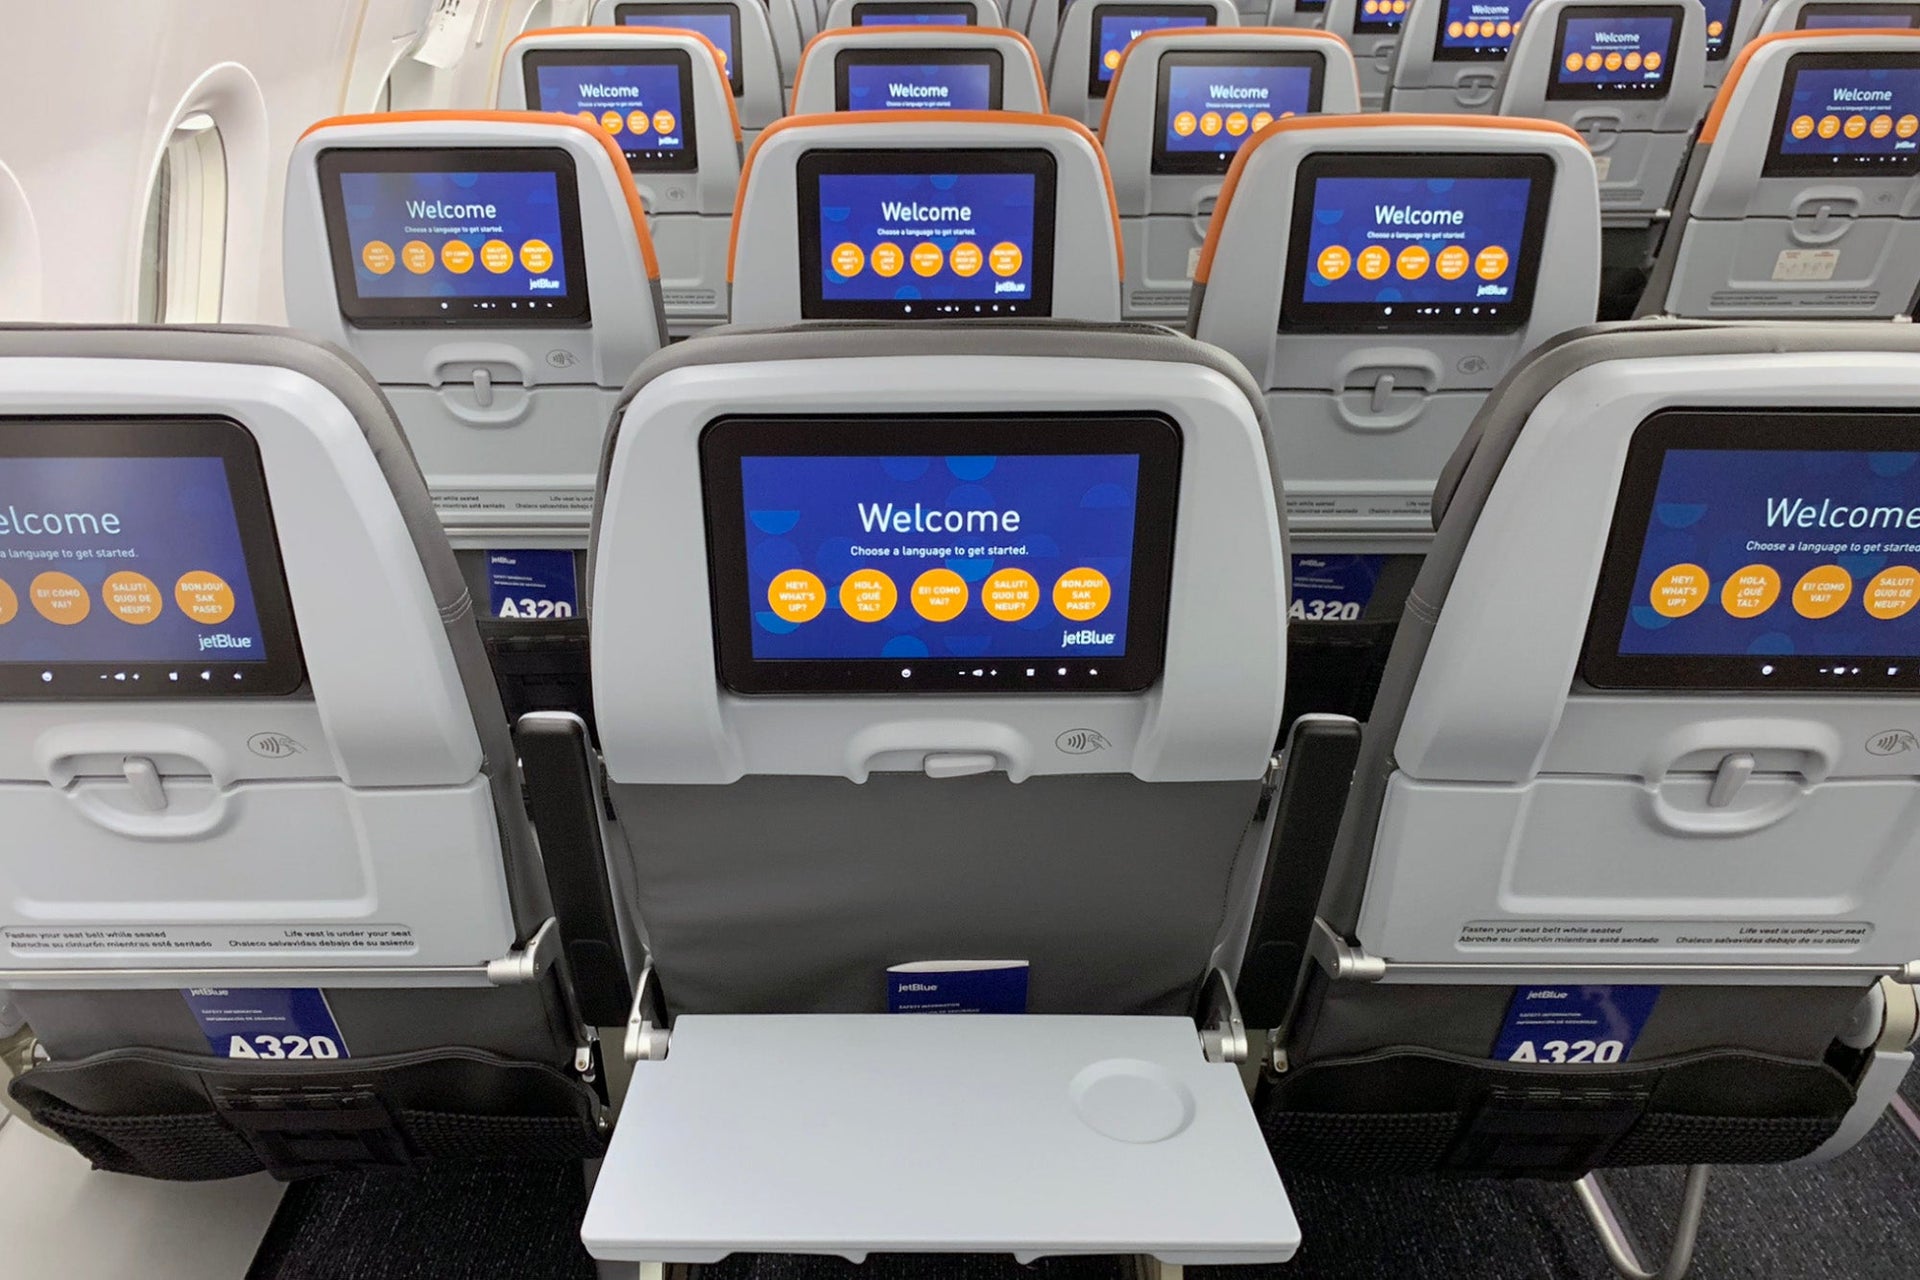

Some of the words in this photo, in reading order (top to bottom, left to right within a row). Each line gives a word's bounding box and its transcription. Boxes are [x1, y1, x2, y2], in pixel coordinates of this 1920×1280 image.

[1595, 32, 1640, 42] Welcome
[578, 84, 640, 98] Welcome
[888, 83, 949, 98] Welcome
[1209, 85, 1269, 99] Welcome
[1833, 88, 1892, 101] Welcome
[406, 200, 496, 218] Welcome
[881, 202, 972, 221] Welcome
[1374, 205, 1464, 224] Welcome
[529, 278, 560, 290] jetBlue
[1476, 284, 1508, 296] jetBlue
[858, 502, 1020, 532] Welcome
[1766, 497, 1920, 528] Welcome
[0, 505, 121, 535] elcome
[850, 546, 890, 556] Choose
[894, 548, 899, 556] a
[903, 546, 951, 558] language
[955, 546, 965, 555] to
[968, 546, 984, 558] get
[988, 546, 1028, 555] started.
[1746, 541, 1786, 551] Choose
[1798, 542, 1847, 554] language
[1850, 542, 1861, 552] to
[1864, 542, 1881, 554] get
[8, 549, 59, 560] language
[62, 549, 73, 558] to
[75, 549, 93, 560] get
[96, 549, 138, 557] started.
[786, 581, 808, 589] HEY!
[994, 580, 1028, 588] SALUT!
[1671, 576, 1694, 584] HEY!
[1880, 578, 1914, 586] SALUT!
[934, 586, 960, 594] COMO
[1816, 583, 1845, 592] COMO
[992, 592, 1014, 600] QUOI
[1016, 592, 1029, 600] DE
[1072, 591, 1092, 599] SAK
[1810, 594, 1832, 602] VAI?
[1874, 589, 1897, 598] QUOI
[1899, 589, 1912, 598] DE
[929, 598, 950, 606] VAI?
[994, 602, 1026, 610] NEUF?
[1066, 602, 1096, 610] PASE?
[1667, 598, 1686, 606] UP?
[1736, 598, 1760, 607] TAL?
[1874, 600, 1906, 609] NEUF?
[499, 597, 572, 618] A320
[788, 604, 808, 612] UP?
[856, 604, 880, 612] TAL?
[1288, 598, 1360, 621] A320
[198, 634, 252, 650] jetBlue
[1062, 630, 1114, 647] jetBlue
[190, 988, 228, 997] jetBlue
[898, 983, 938, 993] jetBlue
[1526, 990, 1568, 1000] jetBlue
[229, 1035, 338, 1059] A320
[1508, 1040, 1624, 1064] A320
